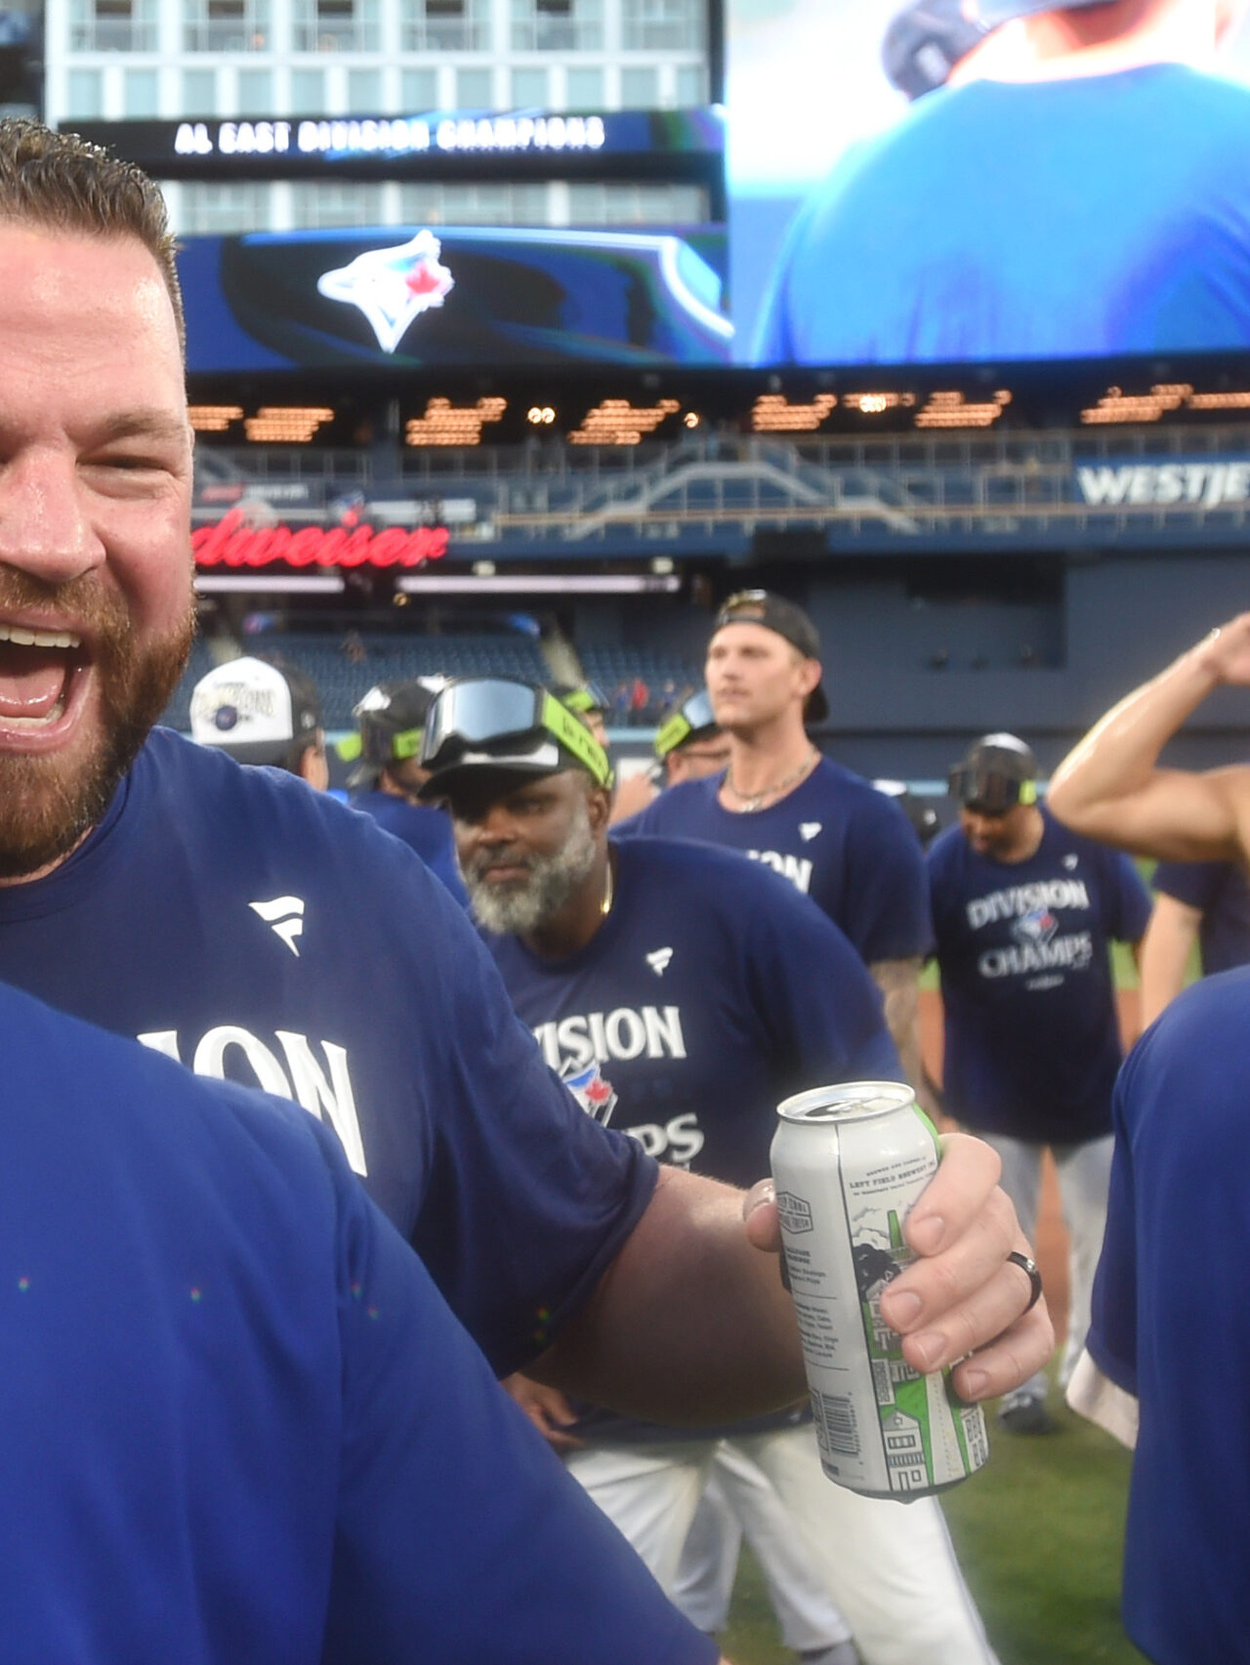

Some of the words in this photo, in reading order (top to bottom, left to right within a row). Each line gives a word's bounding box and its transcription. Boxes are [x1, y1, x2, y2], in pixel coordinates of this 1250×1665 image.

[174, 123, 213, 154] AL
[218, 122, 290, 154] EAST
[298, 119, 430, 153] DIVISION
[437, 116, 605, 151] CHAMPIONS
[1077, 461, 1250, 510] WESTJE
[747, 849, 813, 893] ON
[967, 879, 1090, 929] DIVISION
[978, 932, 1093, 978] CHAMPS
[533, 1006, 688, 1073] ISION
[849, 1180, 870, 1189] LEFT
[873, 1175, 895, 1186] FIELD
